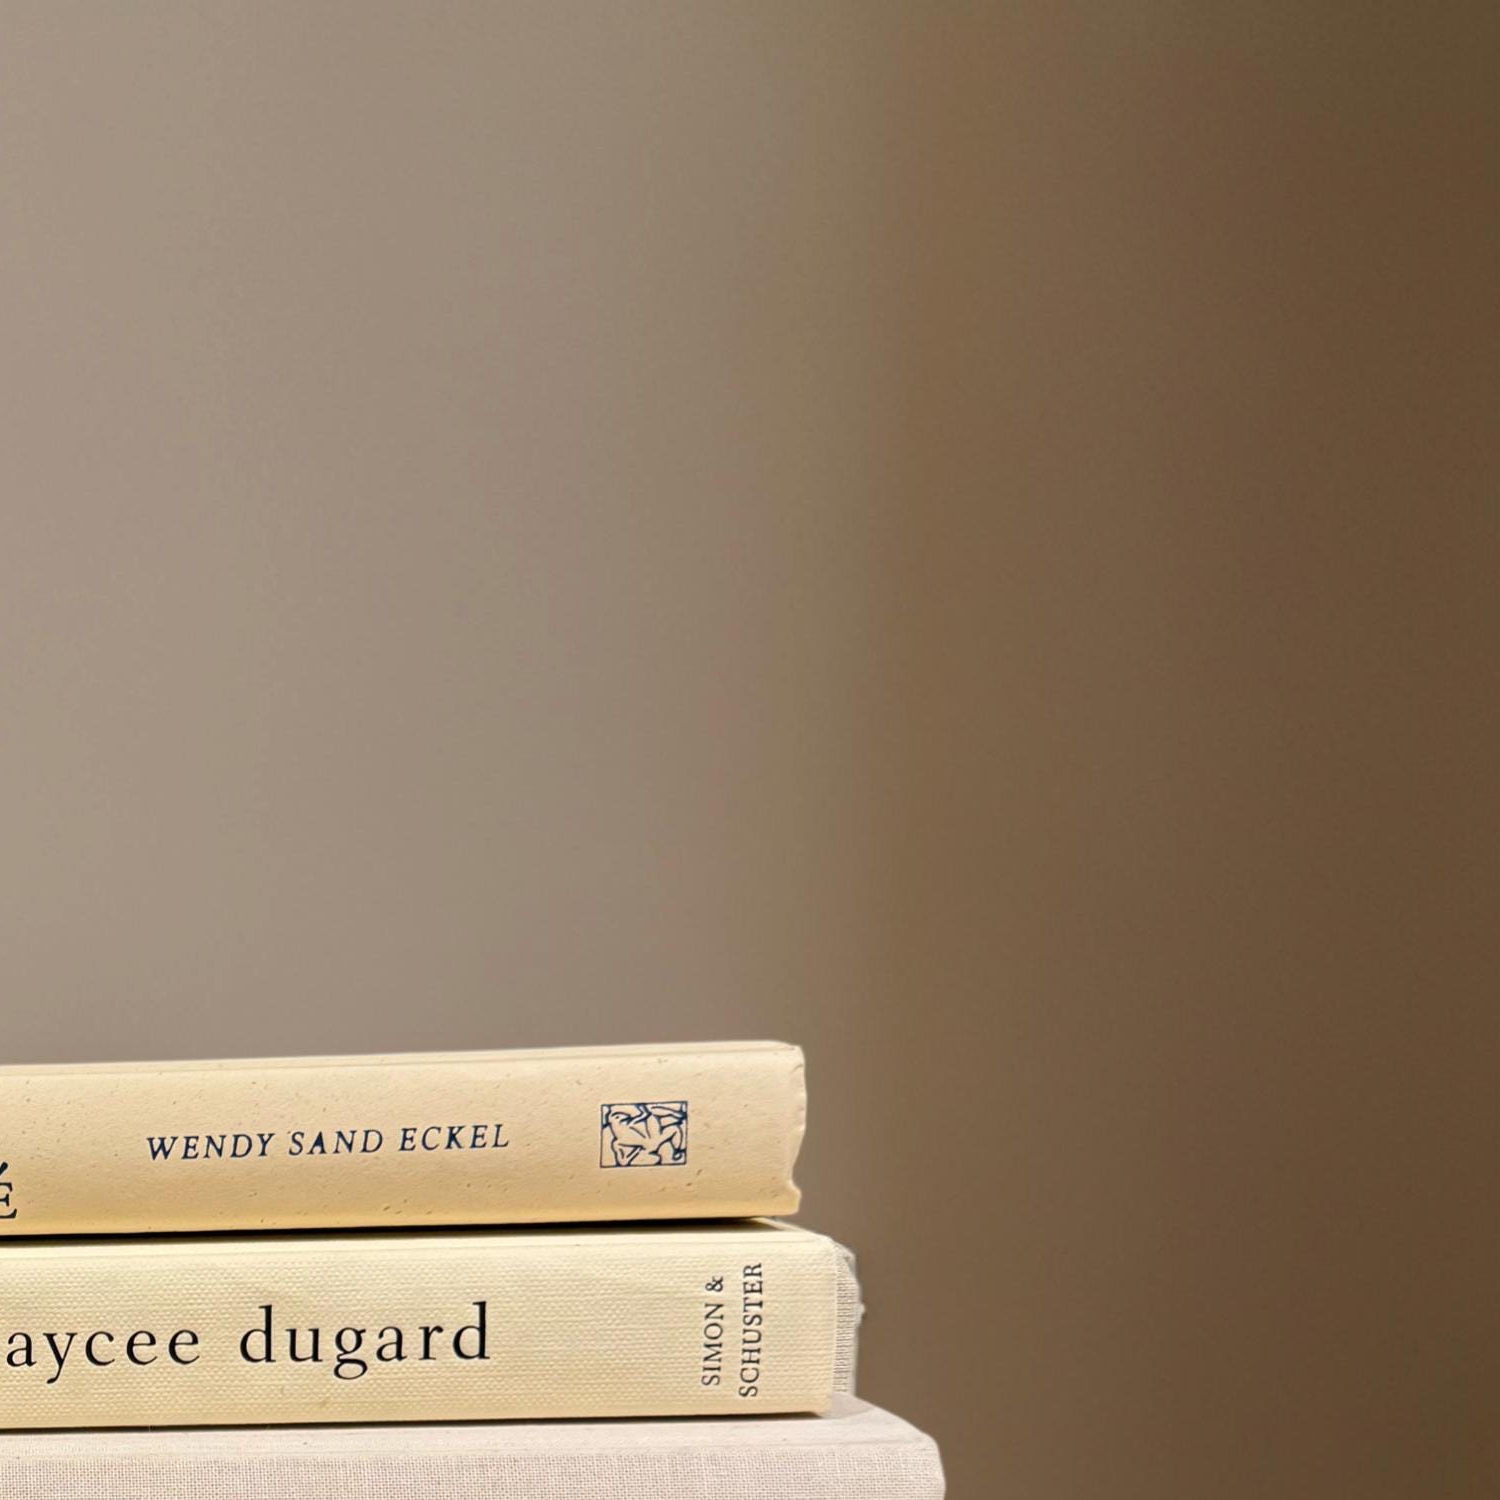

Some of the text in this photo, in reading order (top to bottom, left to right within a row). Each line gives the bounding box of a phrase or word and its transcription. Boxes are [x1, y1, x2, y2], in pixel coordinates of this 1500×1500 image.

[146, 1123, 509, 1160] WENDY SAND ECKEL
[239, 1300, 490, 1381] dugard
[701, 1276, 726, 1387] SIMON &
[738, 1263, 764, 1398] SCHUSTER
